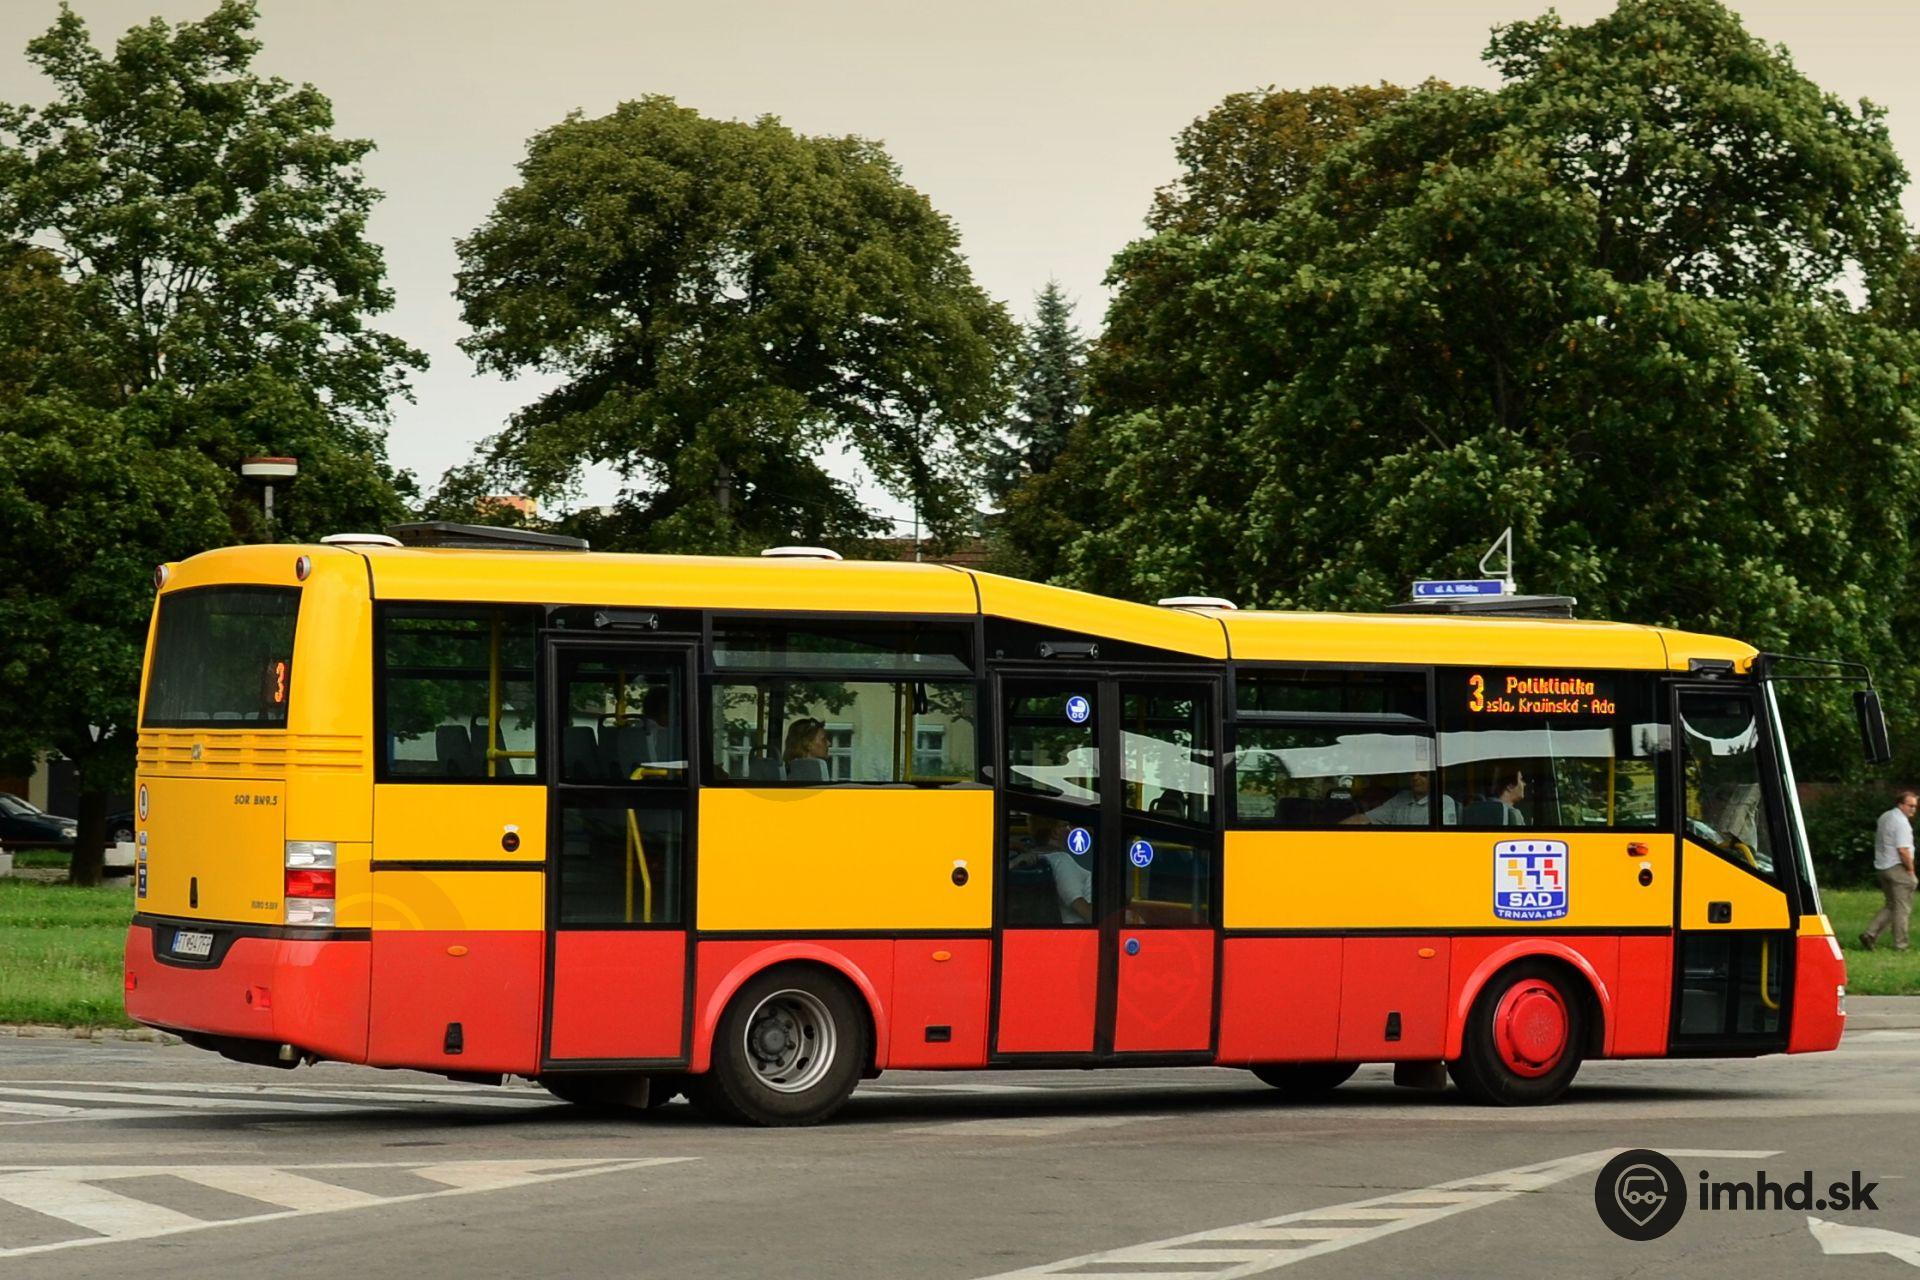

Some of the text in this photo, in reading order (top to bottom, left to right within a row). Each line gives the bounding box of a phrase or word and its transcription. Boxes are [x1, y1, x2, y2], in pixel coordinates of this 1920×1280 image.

[274, 662, 285, 702] 3
[1506, 676, 1595, 695] Poliklinika
[1469, 674, 1485, 712] 3
[1591, 699, 1616, 714] Ada
[234, 794, 250, 805] SOR
[1509, 892, 1552, 907] SAD
